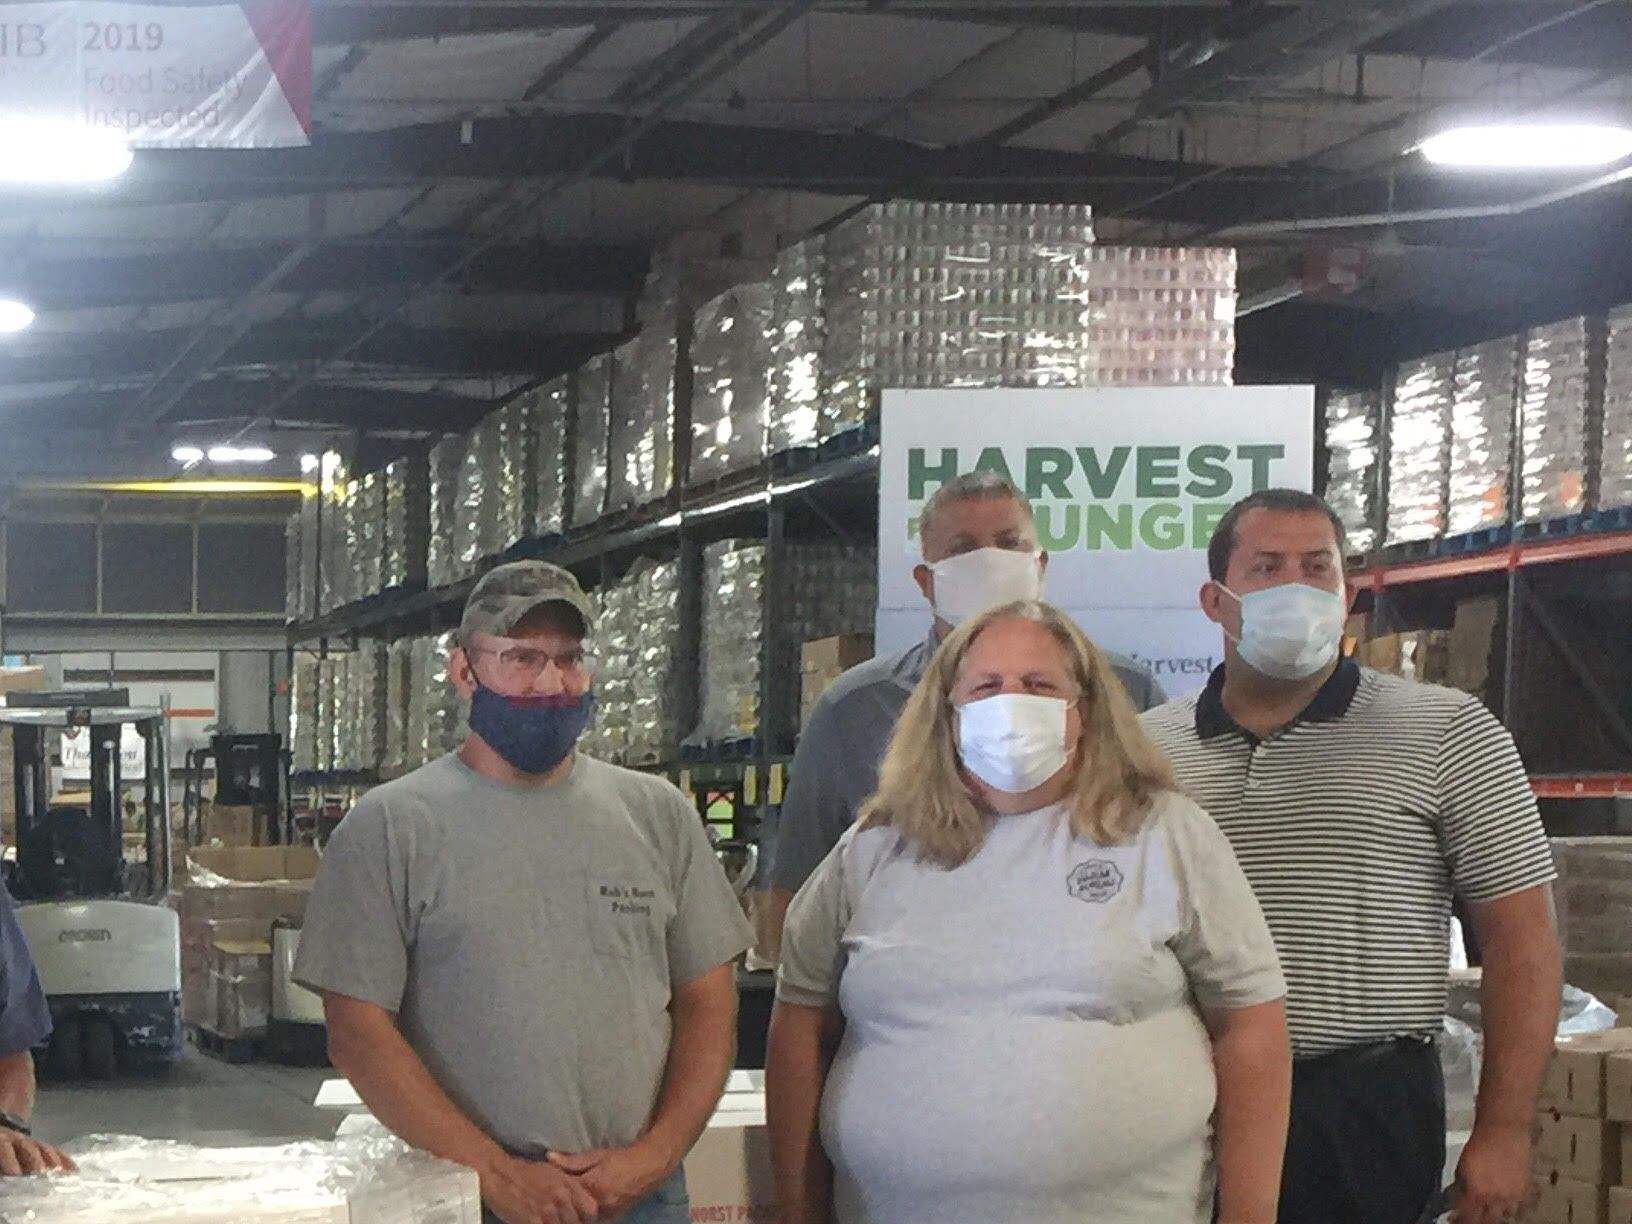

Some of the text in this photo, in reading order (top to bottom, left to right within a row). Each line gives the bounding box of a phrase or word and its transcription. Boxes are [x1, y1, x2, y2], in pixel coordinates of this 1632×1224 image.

[83, 21, 164, 52] 2019
[84, 66, 153, 95] Food
[161, 67, 244, 100] Safety
[85, 104, 220, 133] Inspected
[907, 443, 1286, 500] HARVEST
[1034, 503, 1228, 552] UNGE
